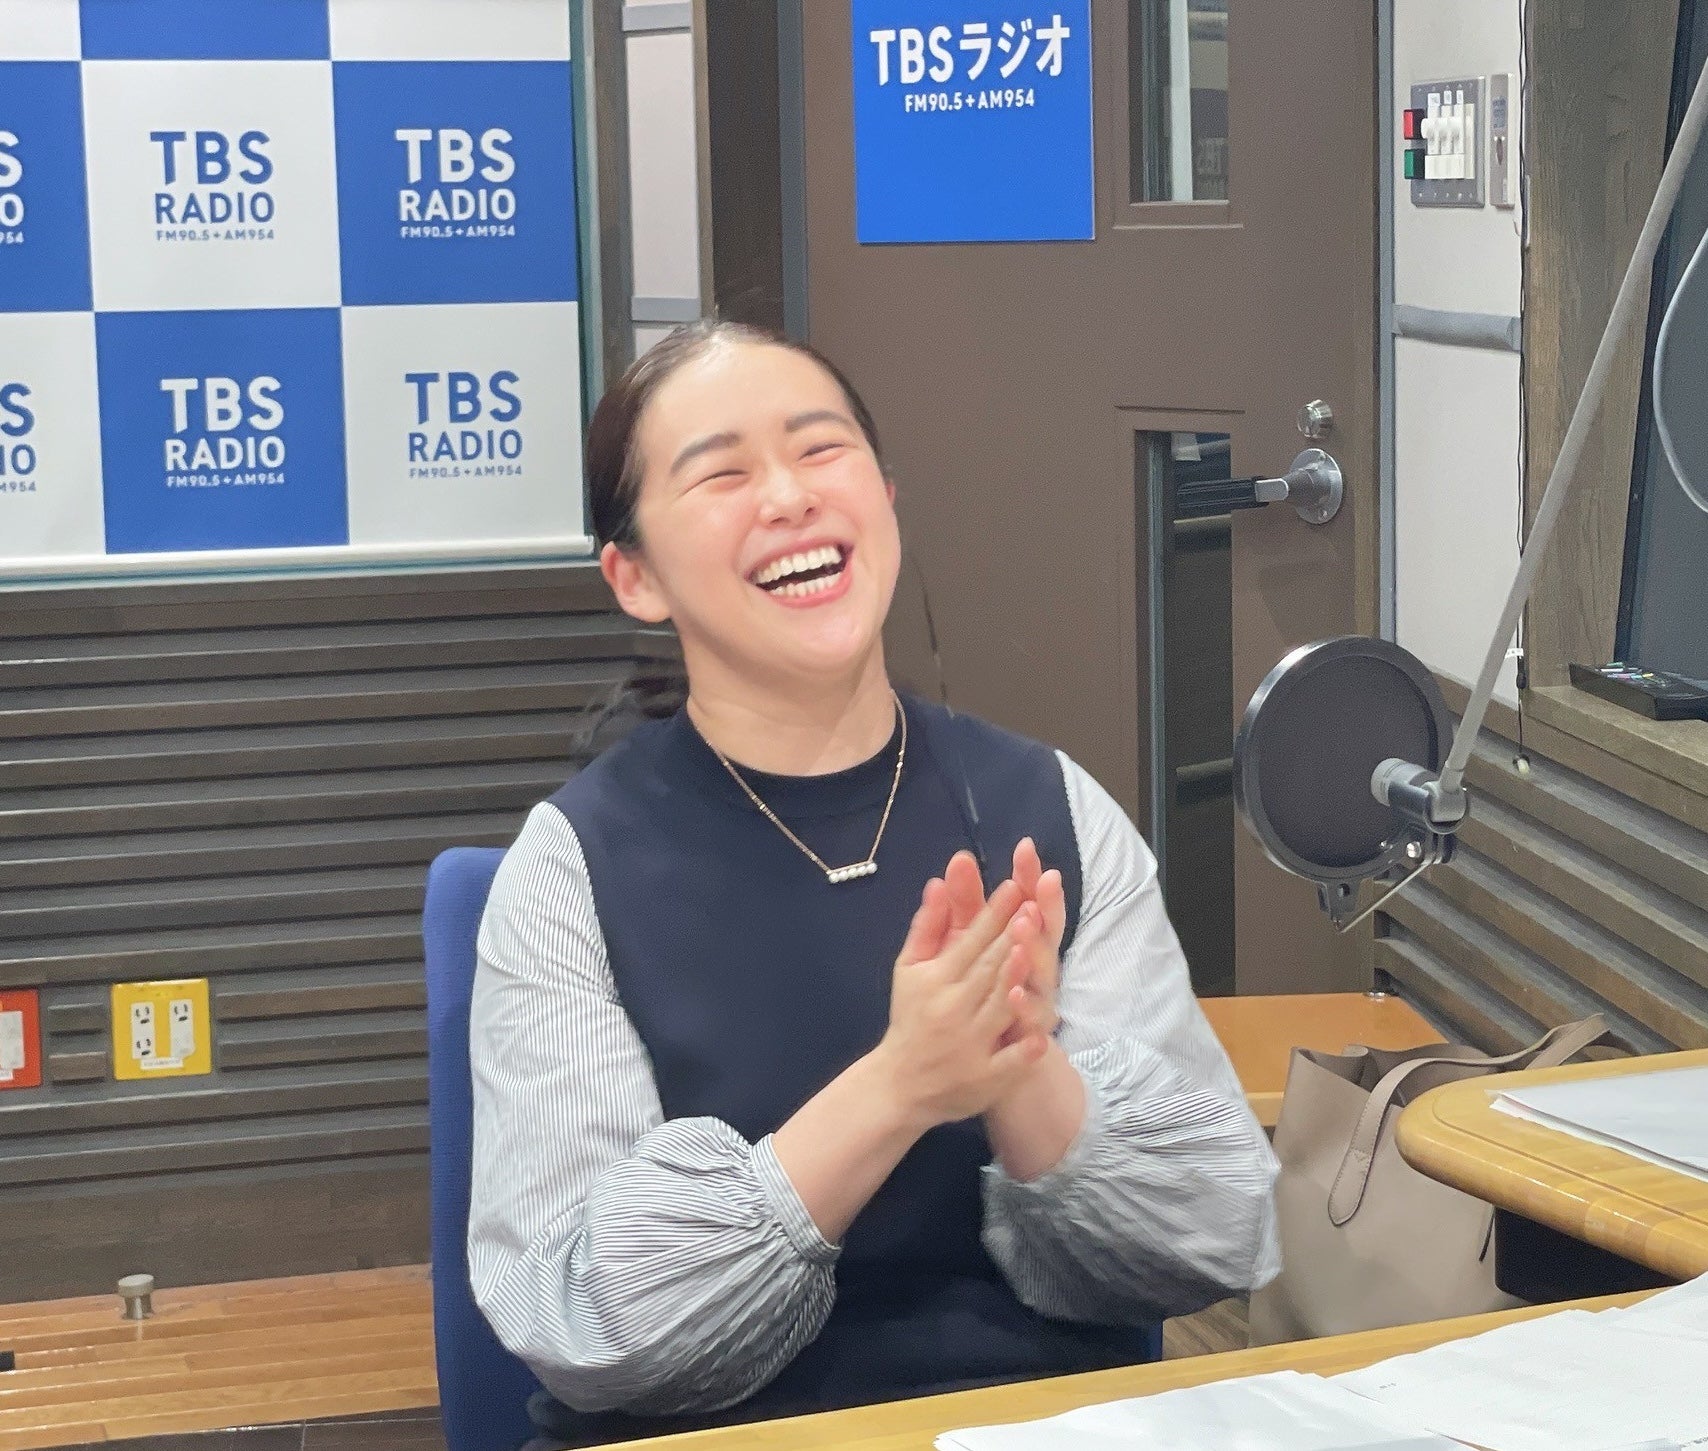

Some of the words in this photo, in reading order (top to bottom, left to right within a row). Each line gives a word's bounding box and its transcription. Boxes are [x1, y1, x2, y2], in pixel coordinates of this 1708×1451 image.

[870, 14, 1070, 86] TBSラジオ
[150, 130, 273, 185] TBS
[395, 128, 515, 184] TBS
[155, 191, 274, 224] RADIO
[400, 188, 516, 221] RADIO
[161, 376, 284, 434] TBS
[405, 370, 522, 425] TBS
[165, 435, 285, 471] RADIO
[408, 429, 523, 462] RADIO
